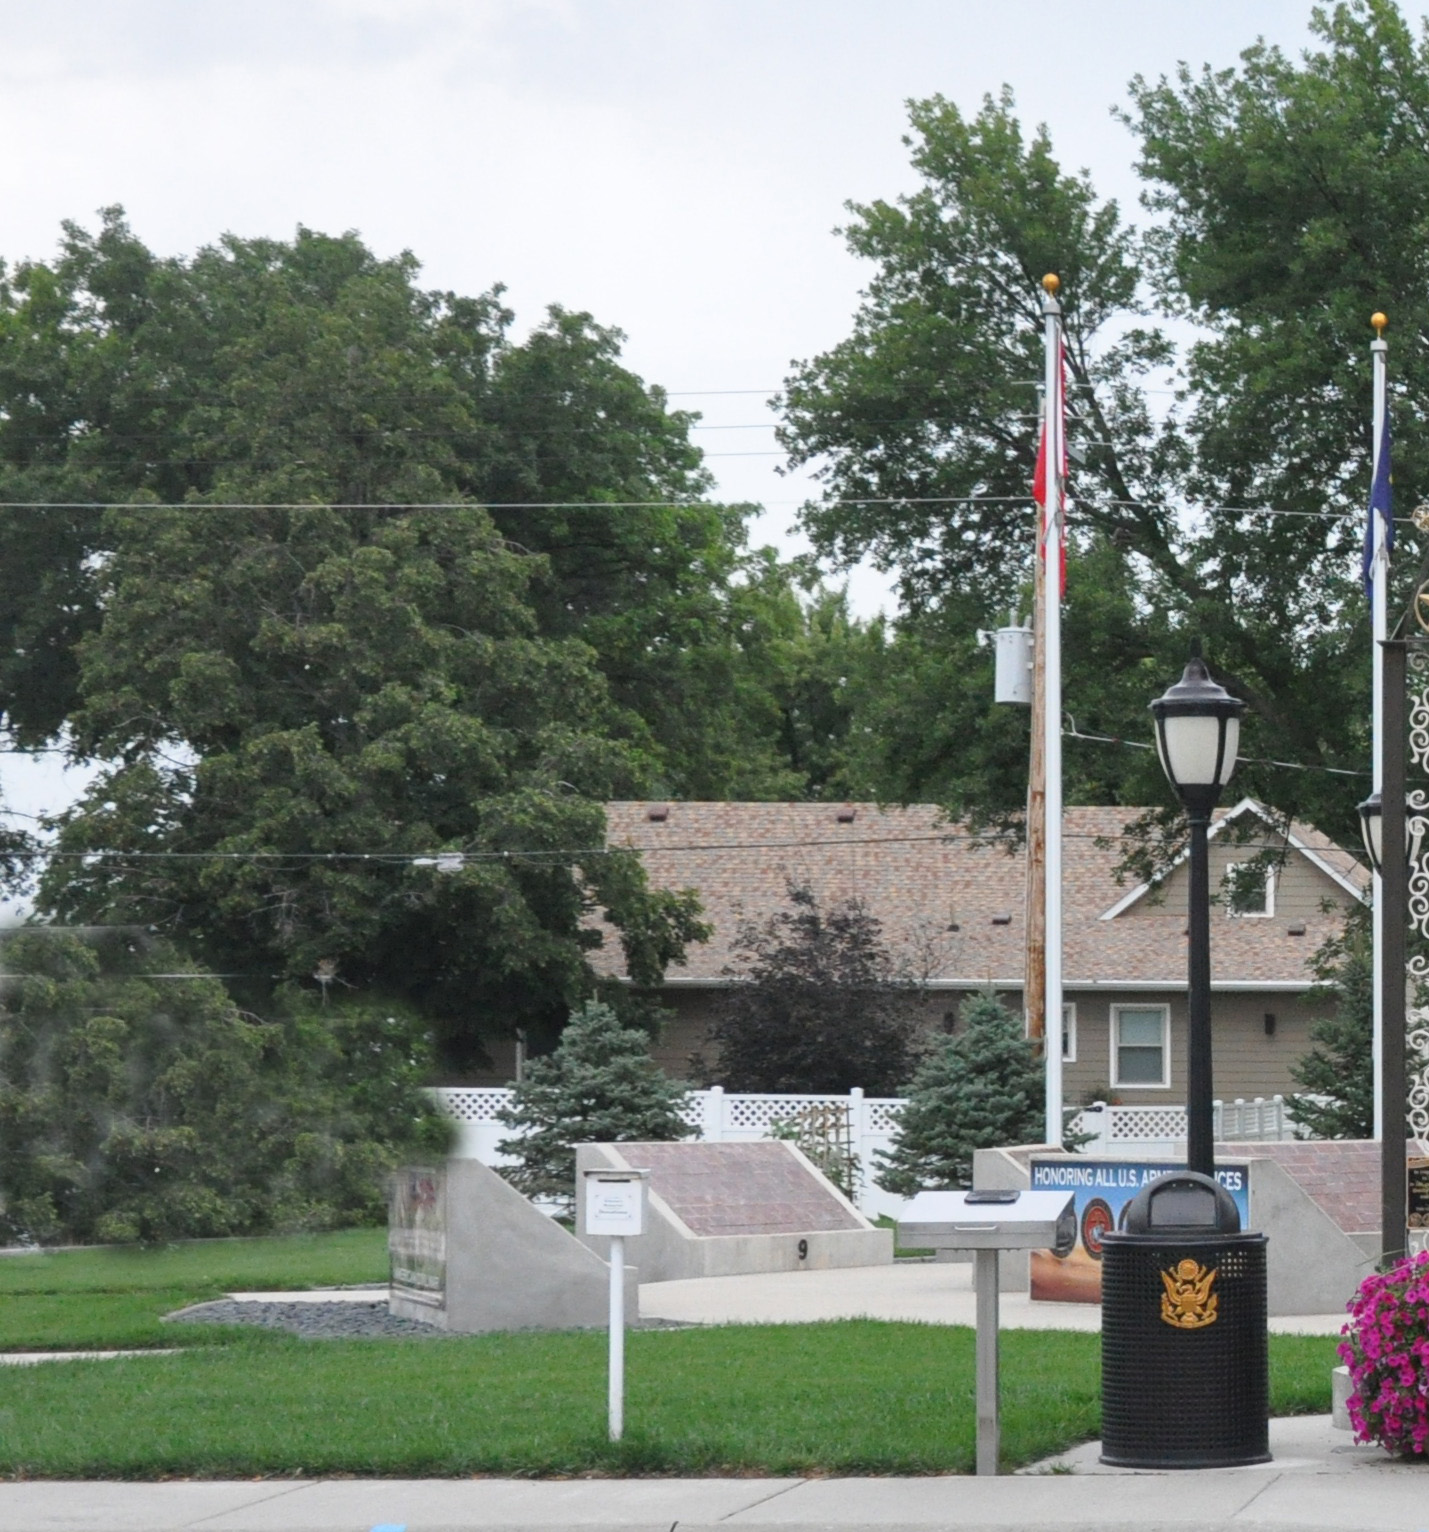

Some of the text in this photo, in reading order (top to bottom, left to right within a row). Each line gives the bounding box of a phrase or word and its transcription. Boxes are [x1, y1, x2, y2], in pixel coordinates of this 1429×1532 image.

[1034, 1166, 1093, 1187] HONORING
[1095, 1169, 1117, 1187] ALL
[1118, 1168, 1139, 1188] U.S.
[797, 1239, 808, 1260] 9
